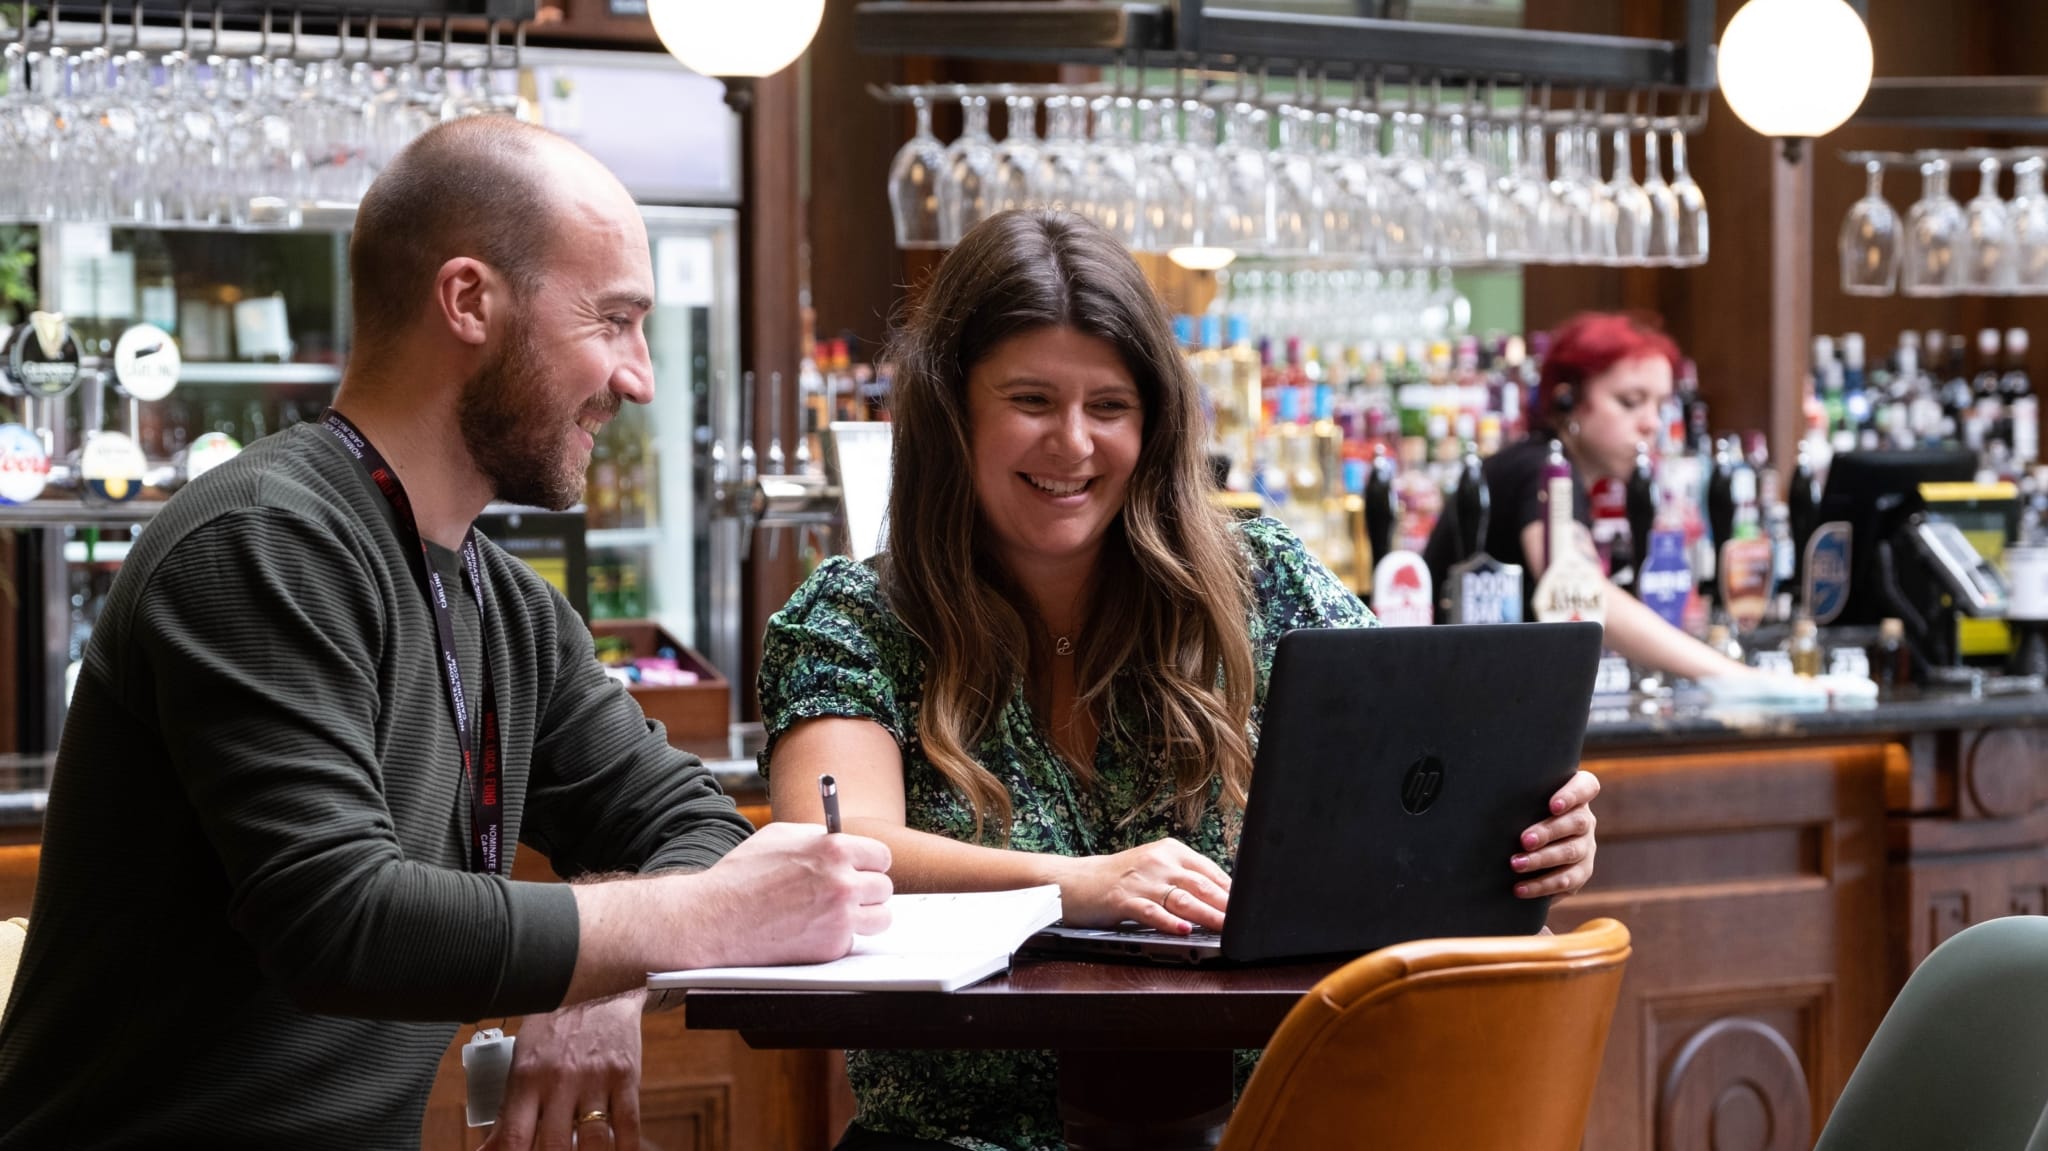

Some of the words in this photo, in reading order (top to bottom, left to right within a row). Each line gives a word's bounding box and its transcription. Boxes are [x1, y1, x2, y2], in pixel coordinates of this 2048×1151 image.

[333, 429, 363, 459] NOMINATE
[466, 542, 480, 584] NOMINATE
[432, 572, 447, 608] CARLING
[445, 651, 451, 660] AT
[448, 663, 456, 685] NOW
[451, 659, 467, 720] CARLING.COM
[452, 686, 464, 731] NOMINATE
[484, 744, 496, 774] LOCAL
[482, 778, 496, 806] FUND
[488, 824, 496, 869] NOMINATE
